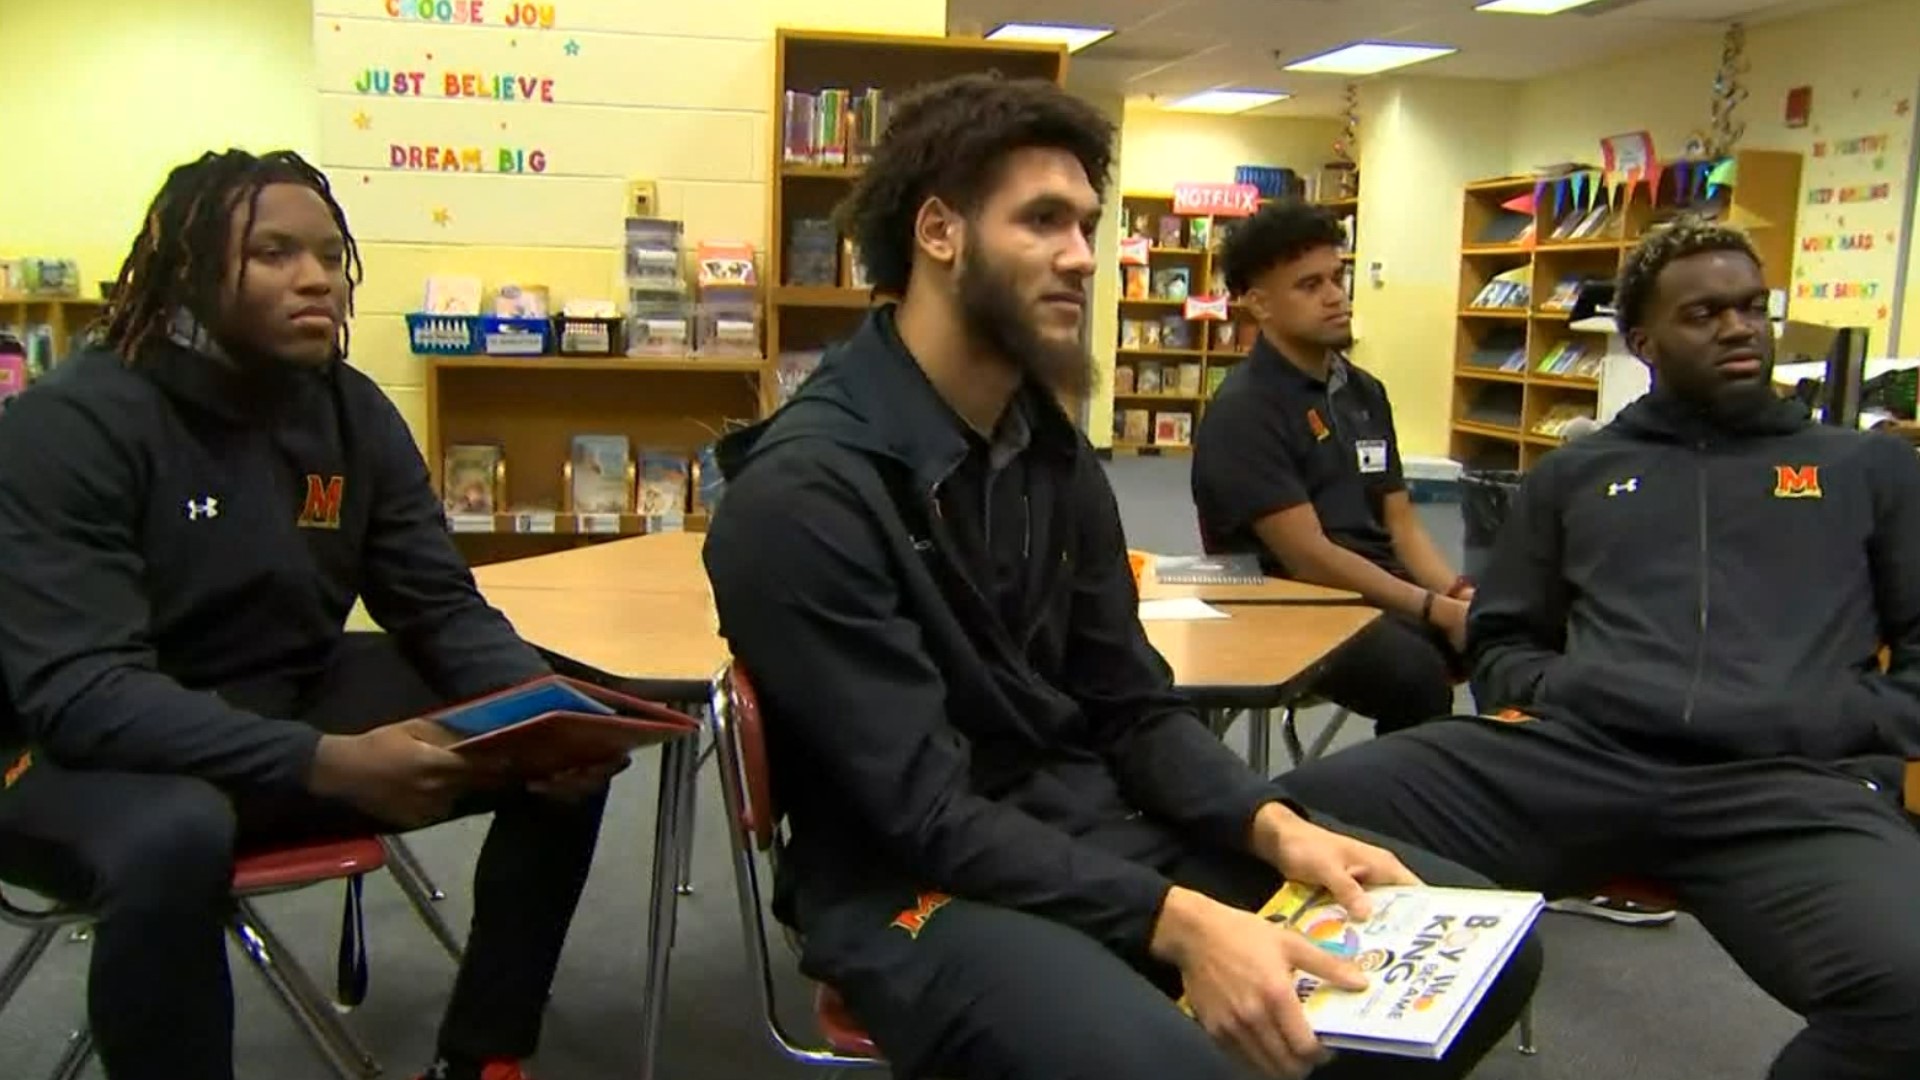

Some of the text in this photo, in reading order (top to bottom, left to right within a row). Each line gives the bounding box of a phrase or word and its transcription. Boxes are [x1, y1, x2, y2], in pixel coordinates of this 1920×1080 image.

[504, 3, 556, 29] JOY
[355, 69, 555, 103] JUST BELIEVE
[390, 144, 547, 173] DREAM BIG
[1175, 187, 1254, 210] NOTFLIX
[1773, 465, 1823, 498] M
[297, 474, 345, 529] M
[1383, 914, 1457, 985] KING
